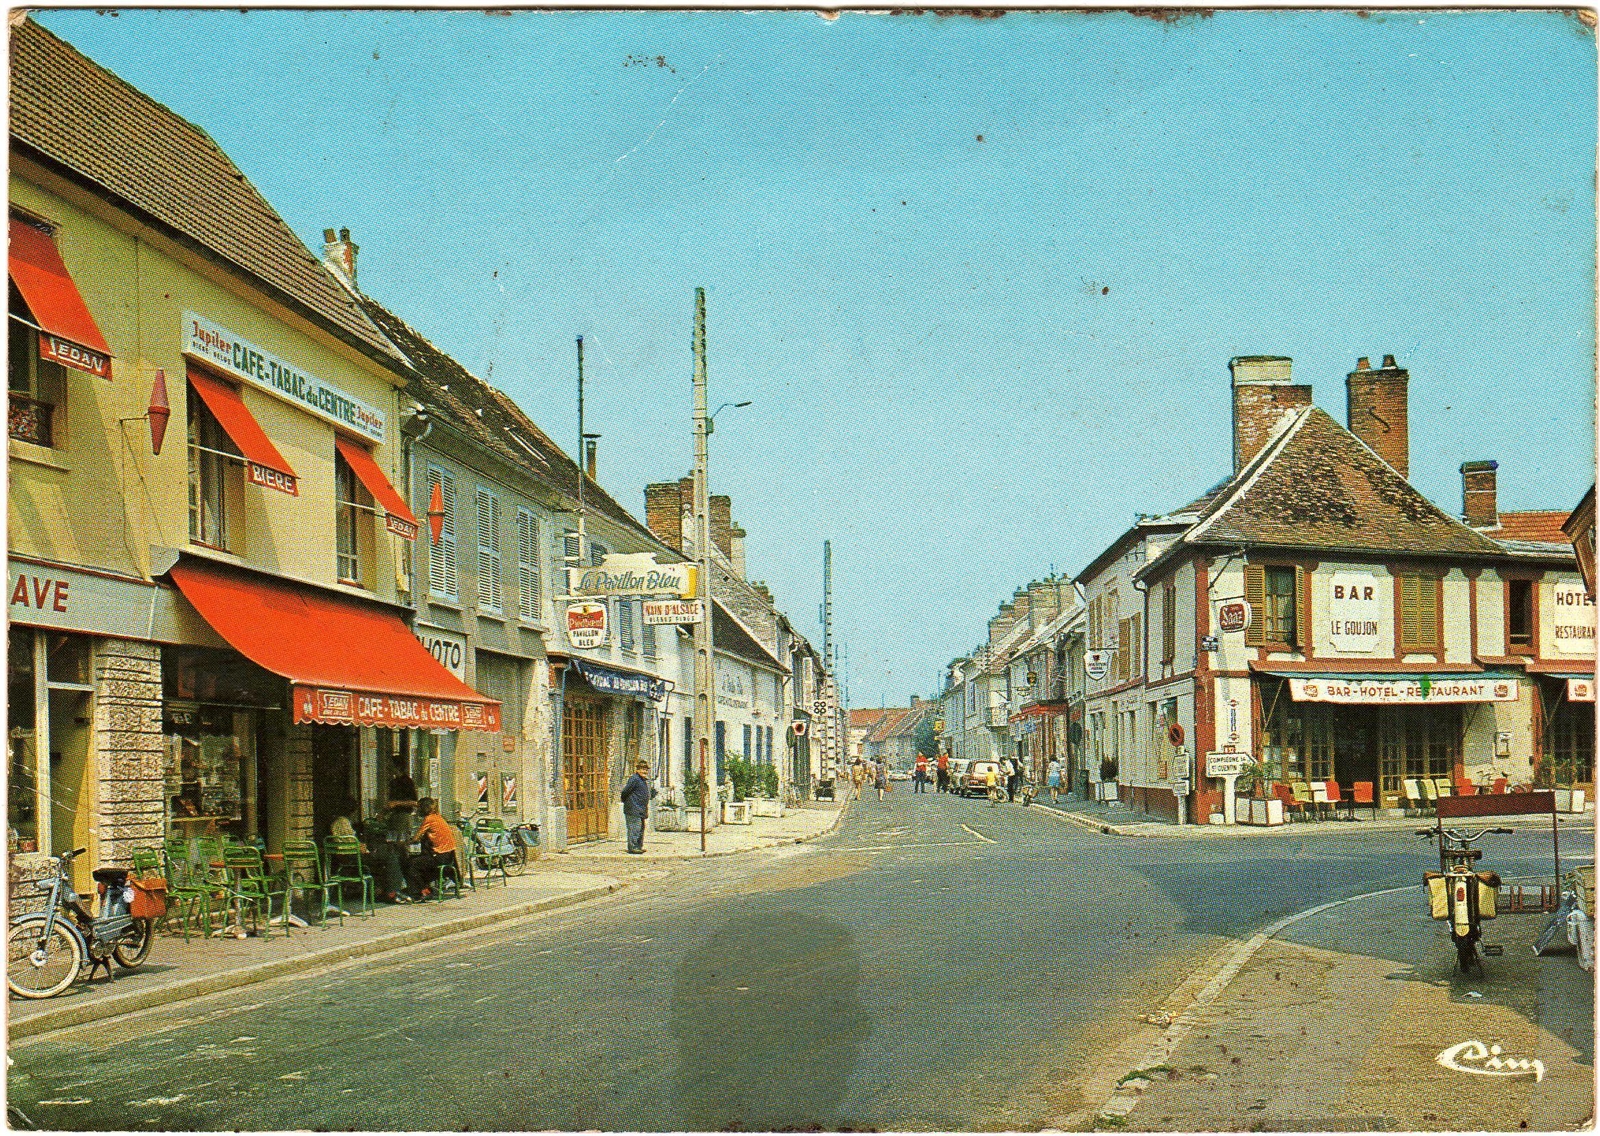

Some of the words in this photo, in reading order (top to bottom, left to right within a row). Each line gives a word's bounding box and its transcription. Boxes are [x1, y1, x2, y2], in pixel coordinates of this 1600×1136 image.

[192, 320, 232, 354] Jupiler
[49, 336, 104, 372] SEDAN
[318, 387, 357, 425] CENTRE
[356, 406, 383, 429] Jupiler
[252, 464, 295, 493] BIERE
[10, 574, 69, 613] AVE
[574, 571, 591, 591] Le
[596, 570, 645, 591] Pavillon
[646, 570, 681, 590] Bleu
[1334, 585, 1374, 601] BAR
[1331, 621, 1341, 636] LE
[1344, 620, 1378, 636] GOUJON
[416, 635, 461, 669] HOTO
[429, 703, 460, 722] CENTRE
